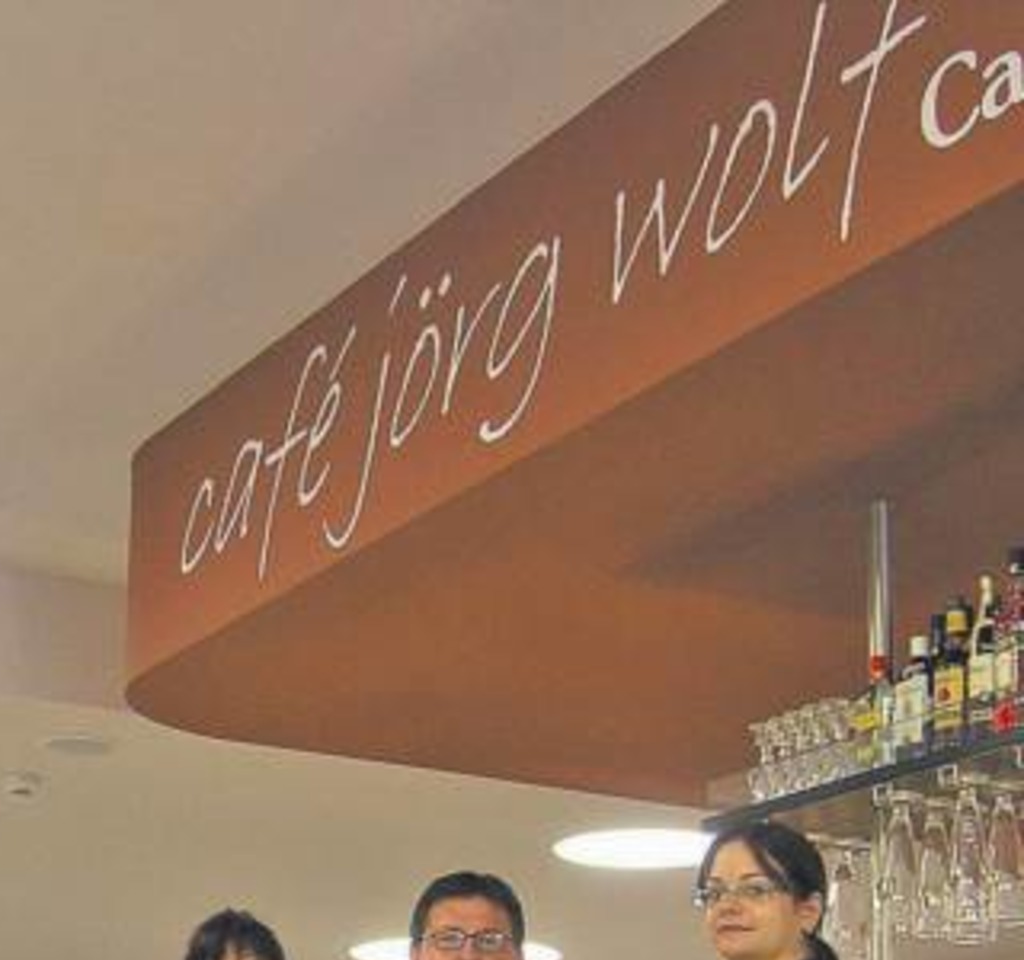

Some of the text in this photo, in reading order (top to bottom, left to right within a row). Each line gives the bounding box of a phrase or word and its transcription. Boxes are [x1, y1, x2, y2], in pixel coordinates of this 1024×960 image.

[180, 0, 926, 580] café jörg wolf
